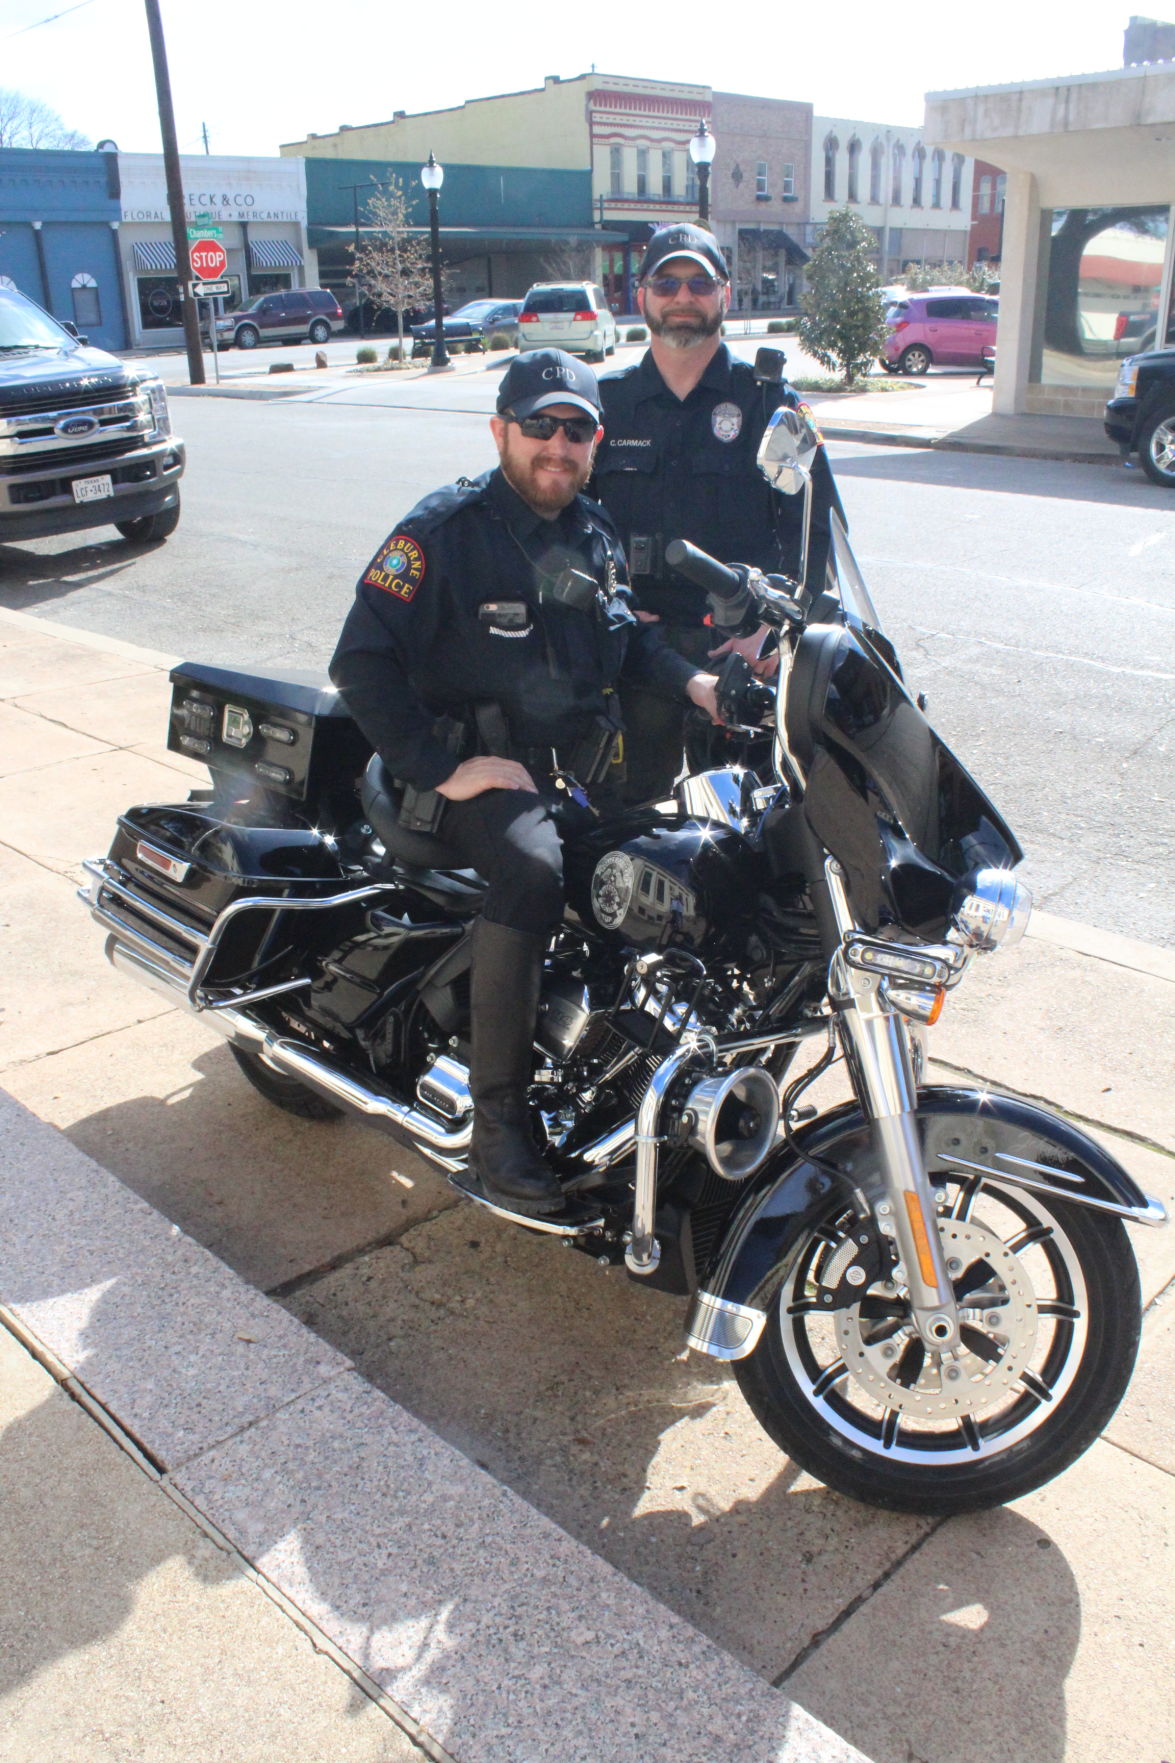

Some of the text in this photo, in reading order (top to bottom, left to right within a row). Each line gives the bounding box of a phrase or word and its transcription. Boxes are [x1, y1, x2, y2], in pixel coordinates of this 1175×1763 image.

[123, 210, 165, 220] FLORAL
[237, 210, 299, 220] MERCANTILE
[192, 252, 224, 267] STOP
[541, 366, 576, 381] CPD
[617, 439, 652, 447] CARMACK
[367, 568, 413, 598] POLICE
